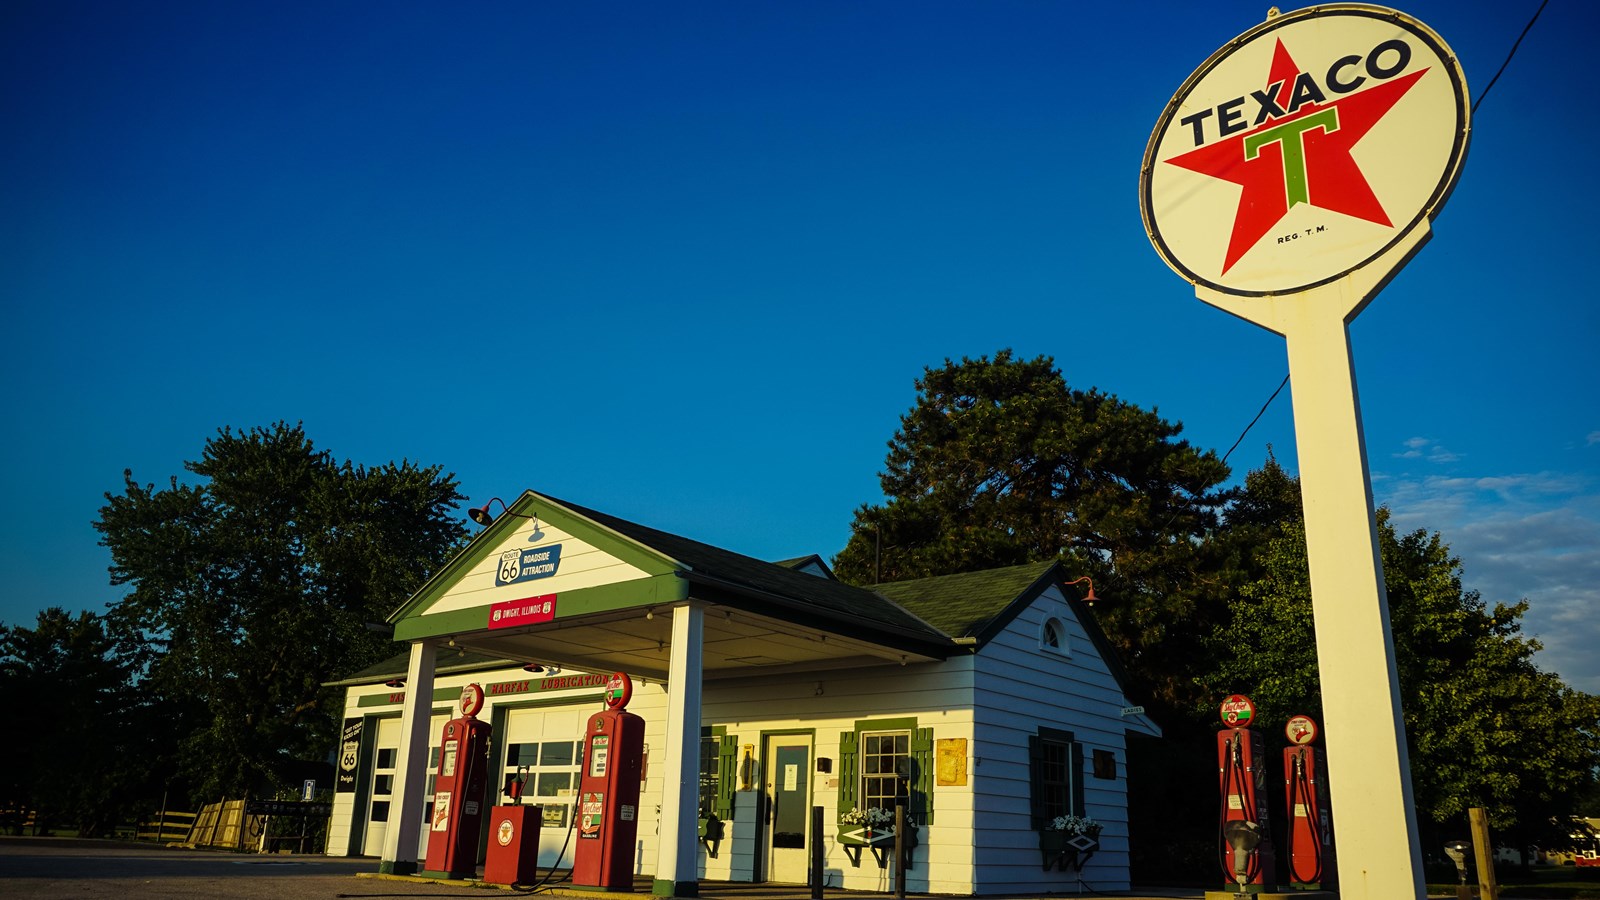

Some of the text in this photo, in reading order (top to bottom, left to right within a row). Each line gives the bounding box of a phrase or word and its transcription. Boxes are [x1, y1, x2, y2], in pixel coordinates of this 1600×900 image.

[1181, 39, 1412, 148] TEXACO
[1245, 106, 1340, 211] T
[1277, 233, 1302, 244] REG.
[504, 551, 519, 559] ROUTE
[523, 551, 550, 564] ROADSIDE
[502, 560, 517, 580] 66
[521, 563, 555, 577] ATTRACTION
[521, 604, 541, 616] ILLINOIS
[540, 675, 609, 690] LUBRICATION
[1233, 702, 1247, 711] Chief
[344, 753, 355, 766] 66
[340, 775, 354, 784] Dwight
[590, 802, 603, 814] Chief
